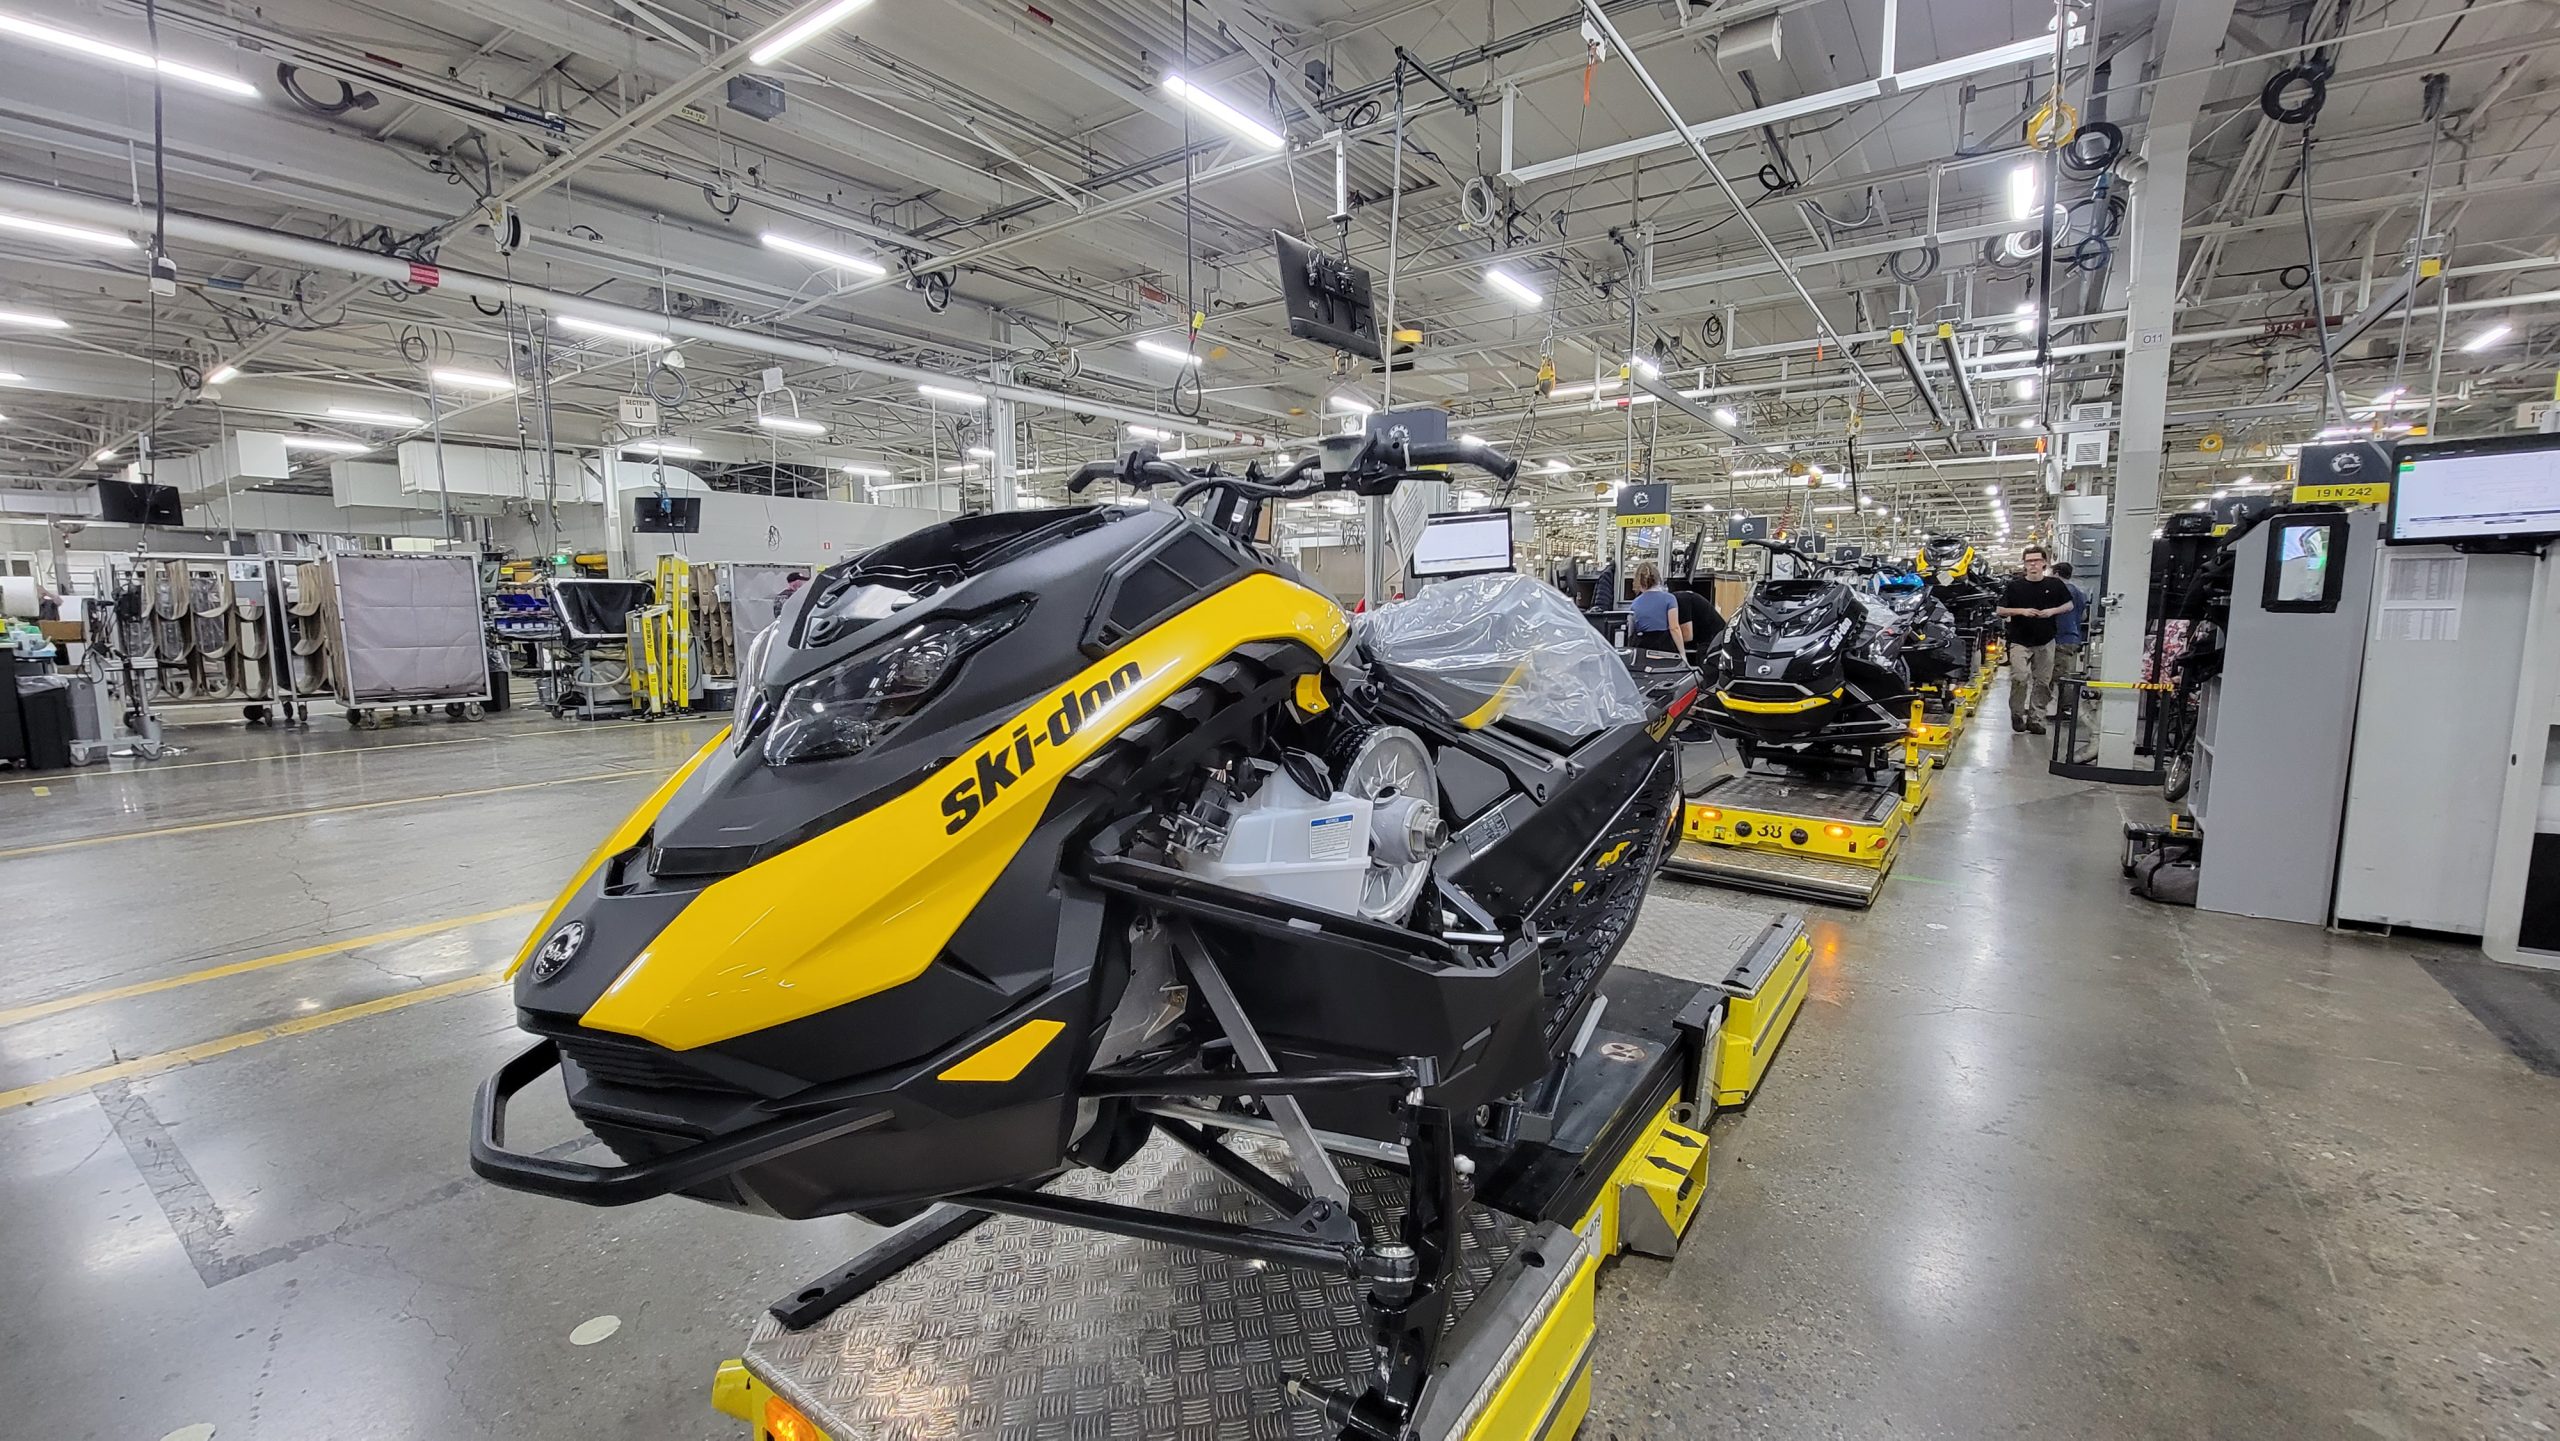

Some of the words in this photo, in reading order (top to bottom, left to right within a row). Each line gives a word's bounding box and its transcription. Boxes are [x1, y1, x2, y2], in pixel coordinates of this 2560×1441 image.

[635, 407, 643, 419] U
[2316, 488, 2331, 497] 19
[2334, 488, 2343, 497] N
[2347, 486, 2372, 496] 242
[1643, 516, 1656, 524] 242
